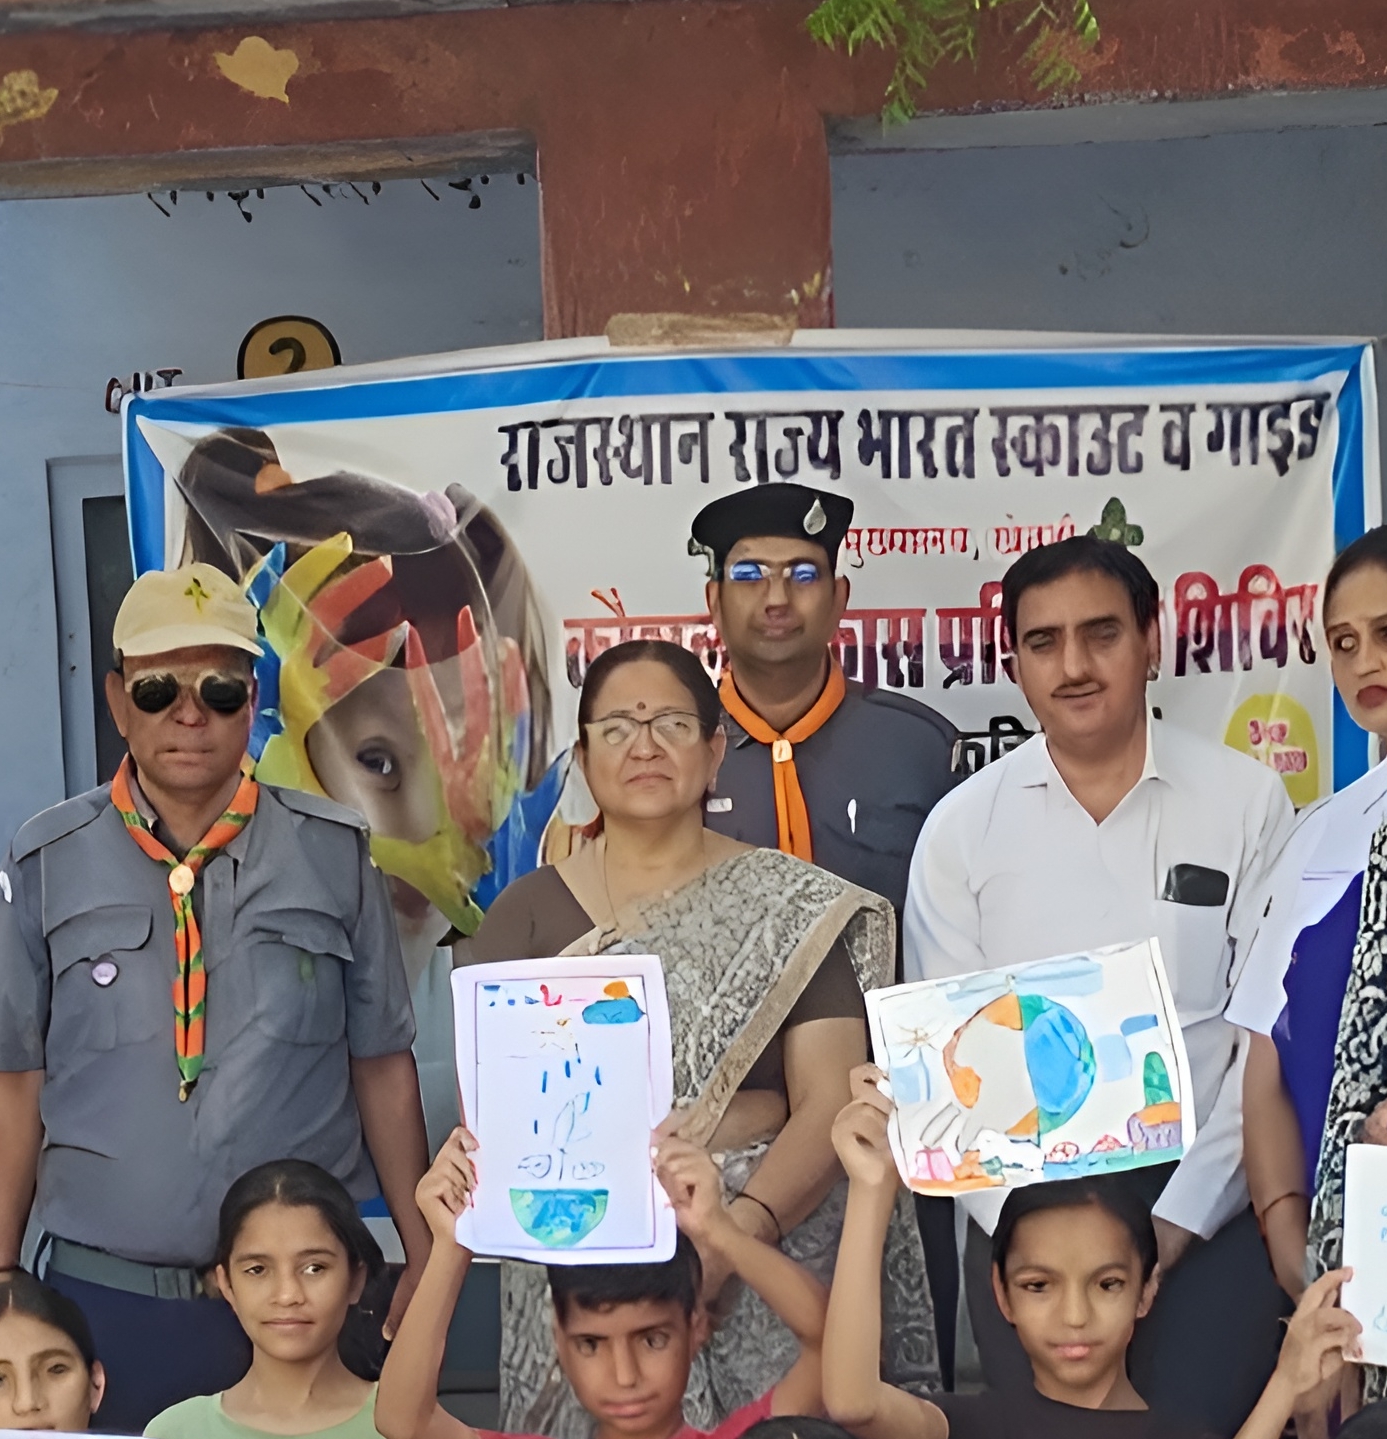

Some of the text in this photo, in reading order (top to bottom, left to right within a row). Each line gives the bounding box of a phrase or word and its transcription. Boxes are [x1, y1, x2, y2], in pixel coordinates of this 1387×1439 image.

[497, 391, 1332, 492] राजस्थान राज्य भारत स्काउट व गाइड
